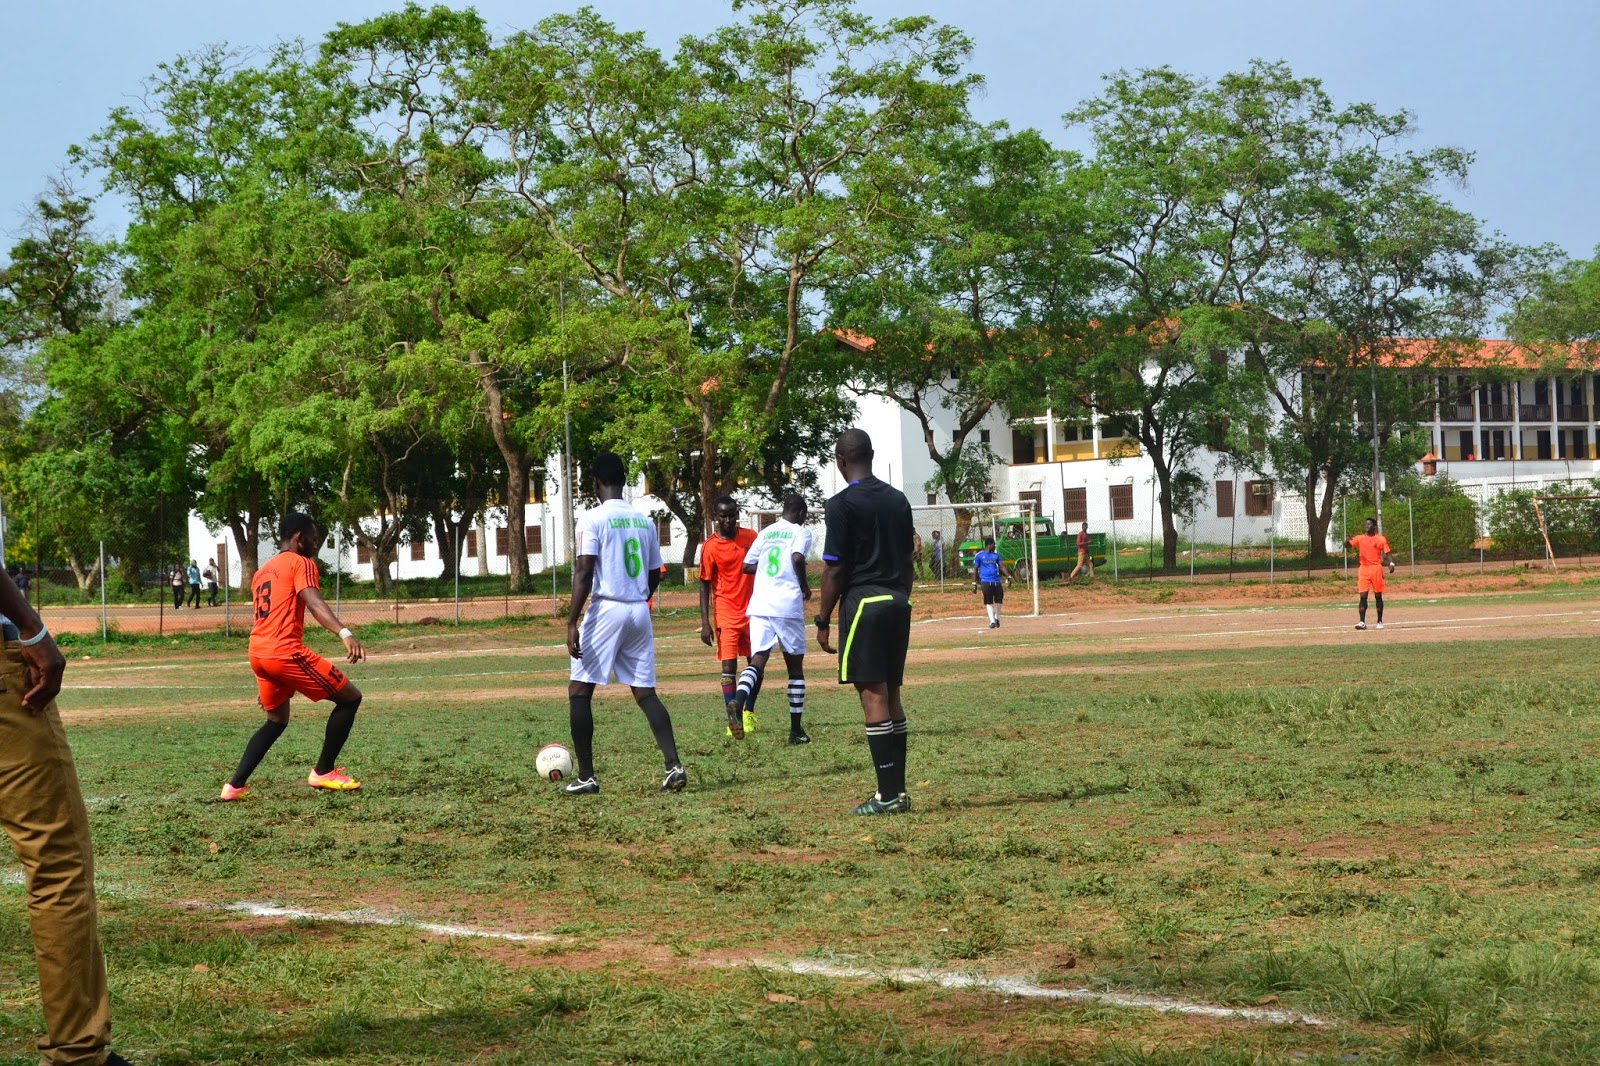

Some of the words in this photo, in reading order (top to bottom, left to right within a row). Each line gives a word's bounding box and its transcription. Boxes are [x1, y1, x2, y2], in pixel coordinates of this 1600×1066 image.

[632, 518, 649, 529] HALL
[624, 537, 641, 579] 6
[767, 545, 780, 577] 8
[255, 580, 271, 620] 13
[328, 665, 344, 683] 13
